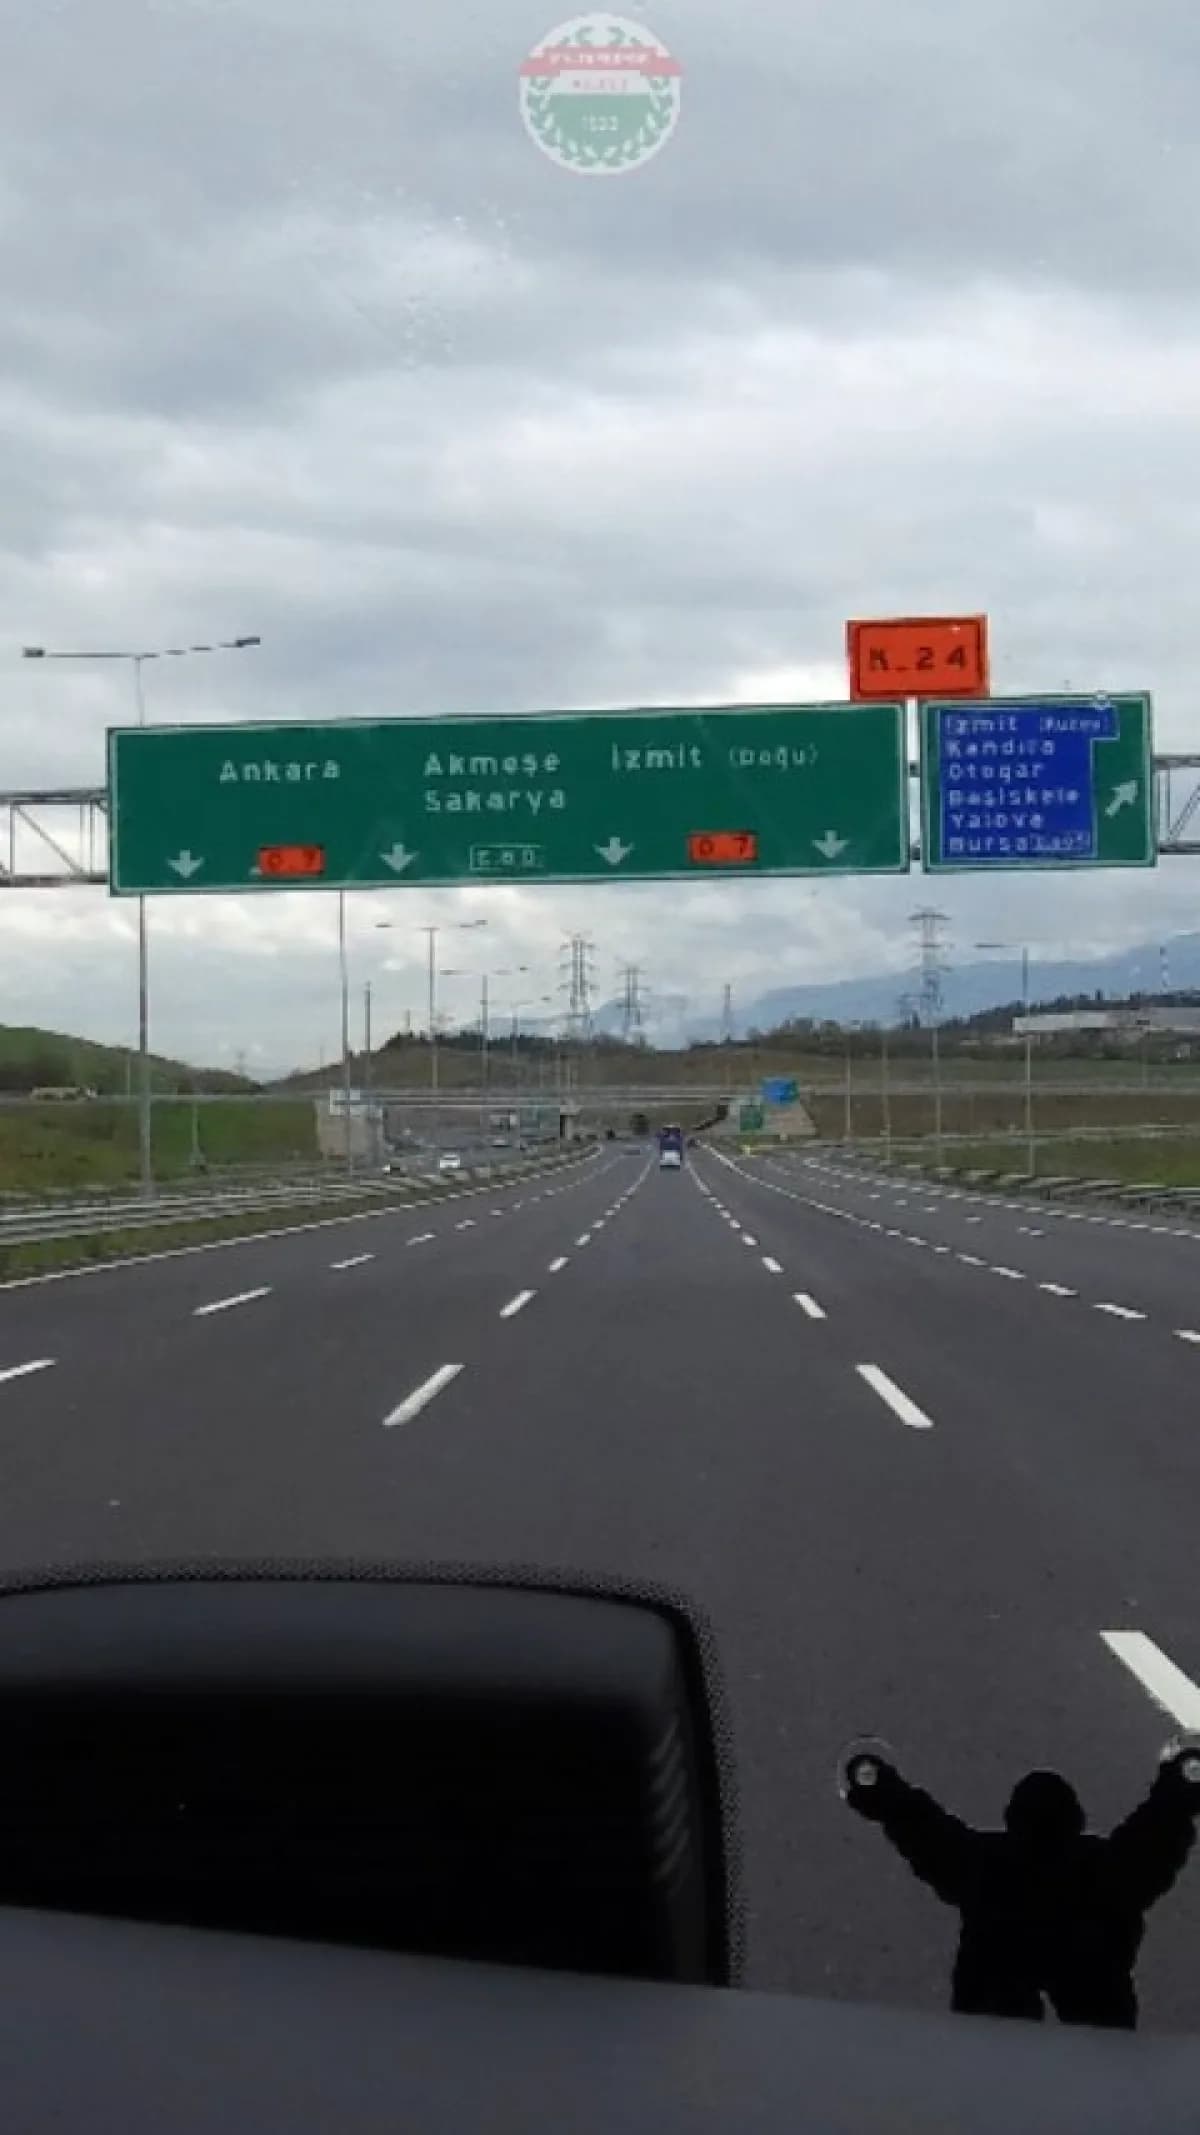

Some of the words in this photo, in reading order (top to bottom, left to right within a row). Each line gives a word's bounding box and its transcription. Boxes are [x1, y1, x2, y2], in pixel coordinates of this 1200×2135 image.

[423, 752, 561, 778] Akmeşe
[611, 741, 702, 769] İzmit
[219, 758, 340, 783] Ankara
[950, 763, 1043, 784] Otogar
[424, 788, 566, 815] Sakarya
[950, 813, 1044, 831] Yalova
[949, 835, 1029, 853] Bursa
